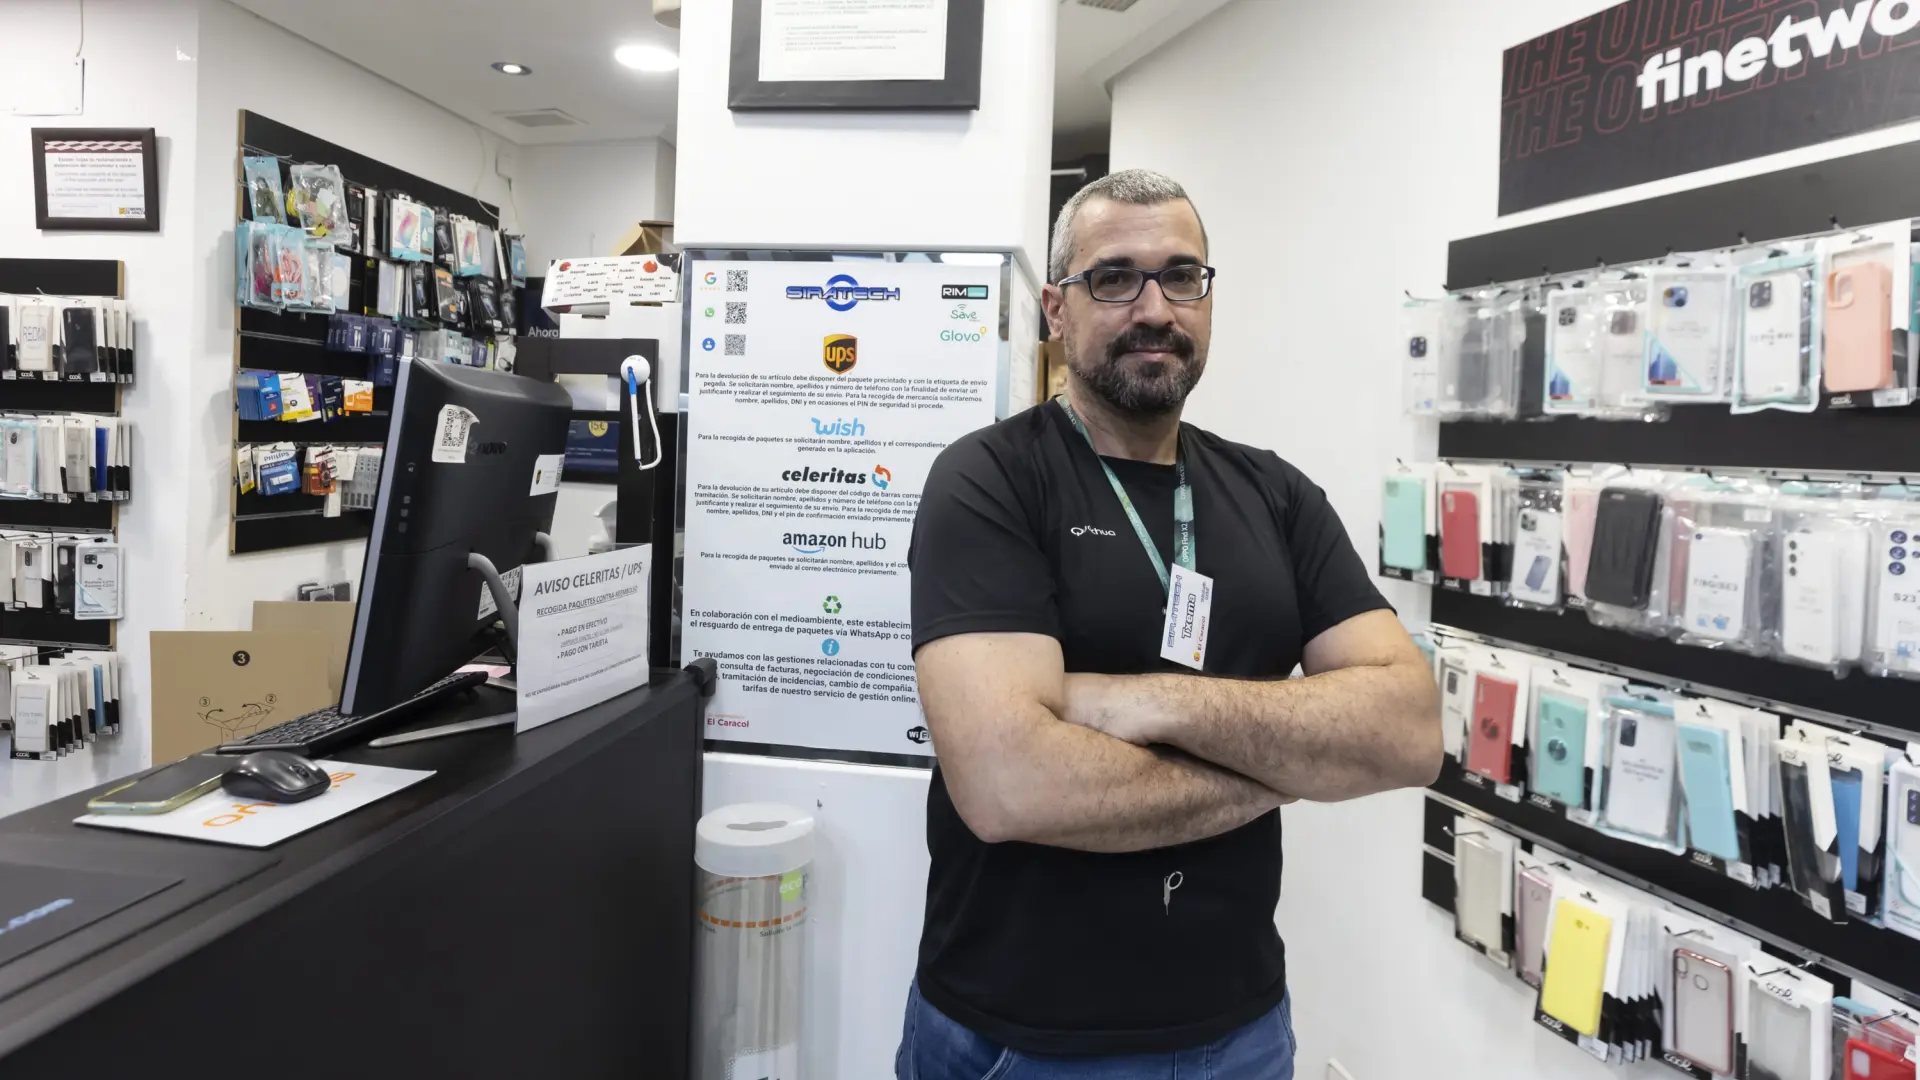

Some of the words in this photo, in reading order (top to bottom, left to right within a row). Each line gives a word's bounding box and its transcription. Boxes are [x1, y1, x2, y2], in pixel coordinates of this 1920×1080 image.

[786, 286, 900, 301] SIRATECH
[942, 287, 967, 296] RIM
[950, 309, 977, 320] Save
[528, 326, 558, 338] Ahora
[940, 330, 981, 342] Glovo
[826, 345, 855, 368] ups
[808, 374, 835, 383] disponer
[847, 375, 872, 384] paquete
[873, 376, 906, 384] precintado
[933, 377, 959, 386] etiqueta
[760, 397, 789, 406] apellidos,
[878, 400, 909, 409] seguridad
[917, 401, 943, 410] procede.
[811, 417, 866, 437] wish
[719, 434, 746, 442] recogida
[755, 435, 783, 444] paquetes
[853, 438, 881, 447] apellidos
[895, 440, 946, 449] correspondiente
[797, 445, 826, 453] generado
[264, 452, 290, 461] PHILIPS
[781, 467, 867, 485] celeritas
[782, 532, 847, 548] amazon
[851, 531, 887, 550] hub
[534, 577, 570, 596] AVISO
[572, 566, 620, 588] CELERITAS
[621, 564, 626, 580] /
[628, 562, 642, 576] UPS
[857, 567, 898, 576] previamente.
[536, 604, 567, 617] RECOGIDA
[568, 598, 596, 610] PAQUETES
[1167, 575, 1182, 648] SIRATECH
[701, 609, 752, 619] colaboración
[780, 614, 844, 626] medioambiente,
[846, 617, 864, 626] este
[1181, 594, 1196, 639] Txema
[561, 626, 577, 636] PAGO
[586, 617, 608, 630] EFECTIVO
[698, 620, 738, 632] resguardo
[752, 623, 782, 634] entrega
[796, 626, 833, 637] paquetes
[849, 629, 891, 640] WhatsApp
[560, 648, 576, 659] PAGO
[577, 645, 588, 654] CON
[588, 638, 608, 651] TARJETA
[237, 653, 246, 664] 3
[704, 650, 744, 662] ayudamos
[762, 653, 774, 661] las
[776, 654, 814, 666] gestiones
[816, 656, 868, 667] relacionadas
[720, 661, 753, 670] consulta
[755, 663, 765, 671] de
[766, 664, 801, 675] facturas,
[803, 666, 852, 679] negociación
[853, 670, 864, 678] de
[865, 670, 918, 682] condiciones,
[722, 672, 766, 682] tramitación
[779, 675, 827, 686] incidencias,
[828, 678, 858, 687] cambio
[860, 680, 870, 688] de
[742, 684, 767, 692] tarifas
[769, 685, 779, 693] de
[781, 686, 811, 695] nuestro
[813, 688, 844, 697] servicio
[858, 691, 889, 702] gestión
[890, 693, 920, 702] online.
[707, 718, 716, 726] El
[718, 718, 750, 728] Caracol
[1766, 982, 1793, 1001] cool
[1540, 1014, 1563, 1031] cool
[1664, 1053, 1692, 1071] cool
